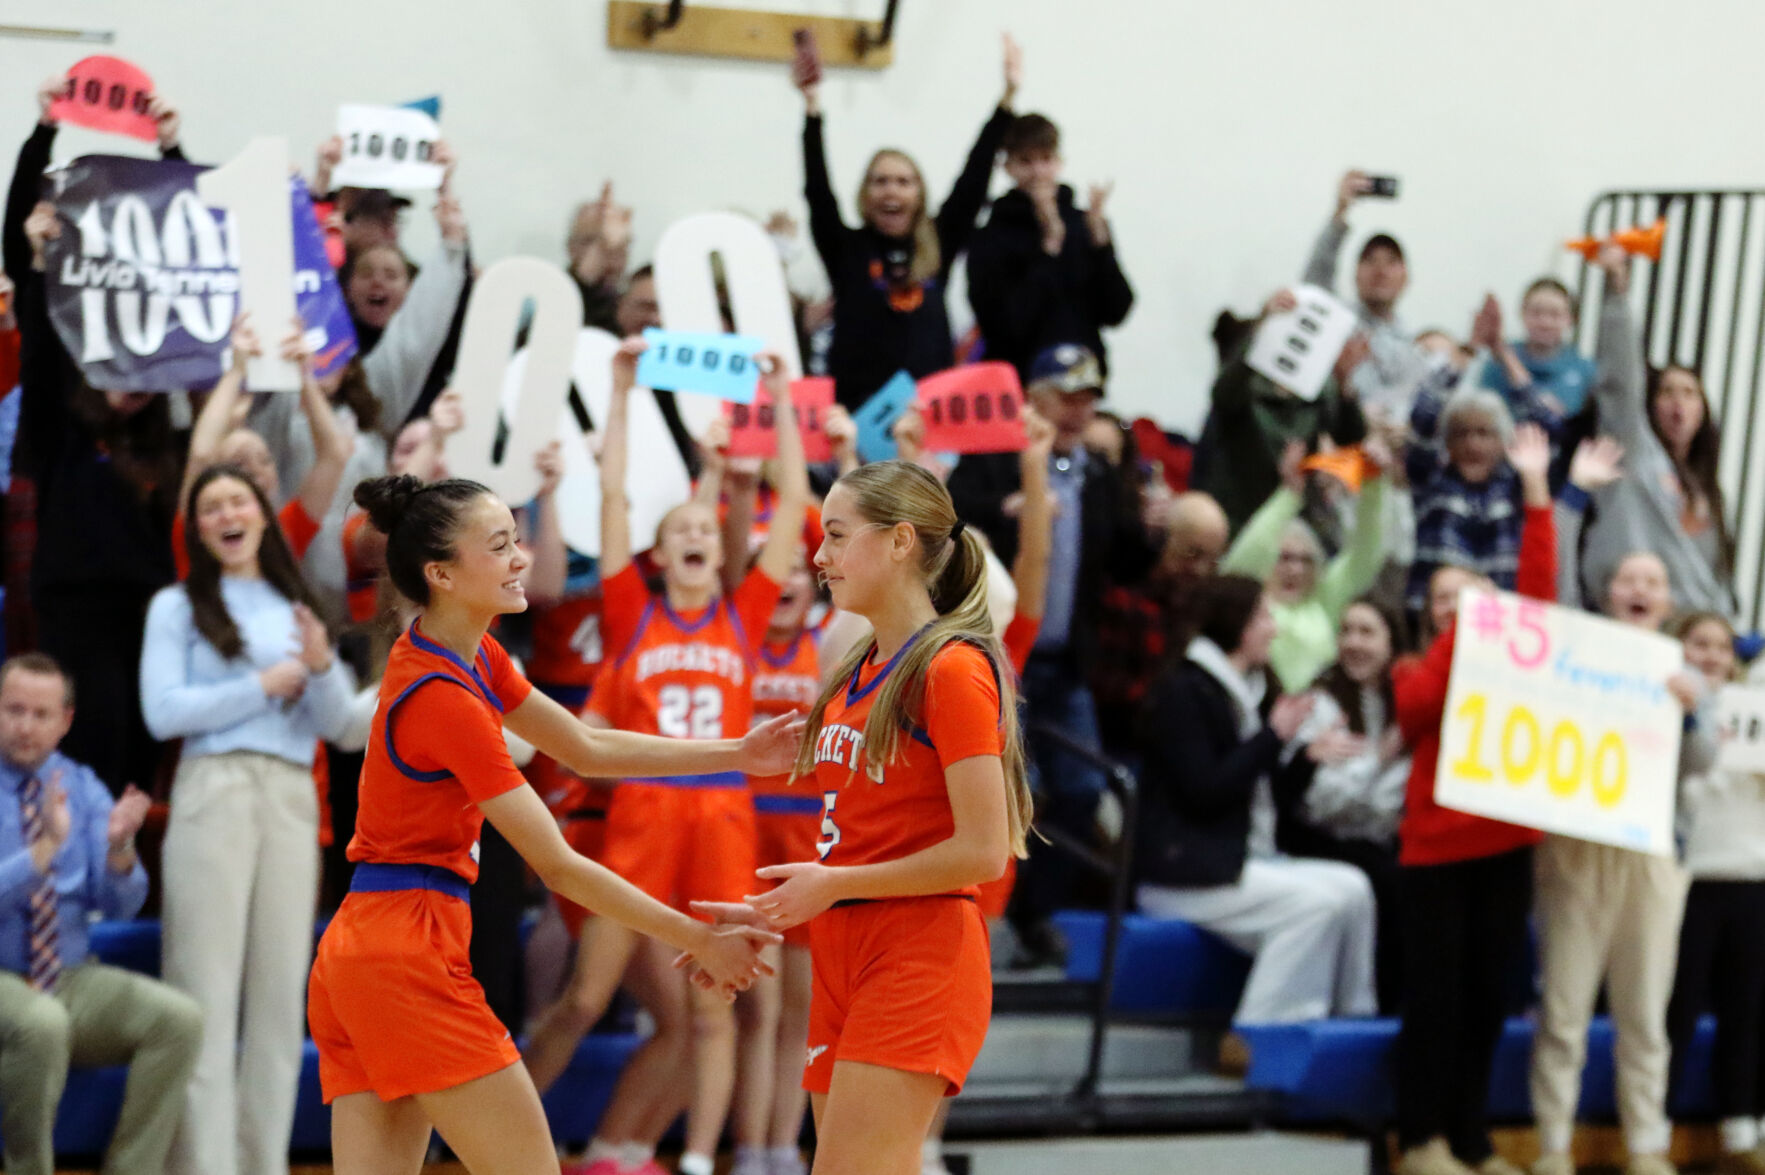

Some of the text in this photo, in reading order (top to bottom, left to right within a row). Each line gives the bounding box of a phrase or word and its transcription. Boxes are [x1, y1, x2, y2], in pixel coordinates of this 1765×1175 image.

[66, 77, 151, 116] 1000
[350, 131, 433, 164] 1000
[656, 345, 750, 374] 1000
[930, 394, 1018, 425] 1000
[658, 685, 724, 739] 22
[1452, 692, 1629, 810] 1000
[815, 790, 842, 861] 5
